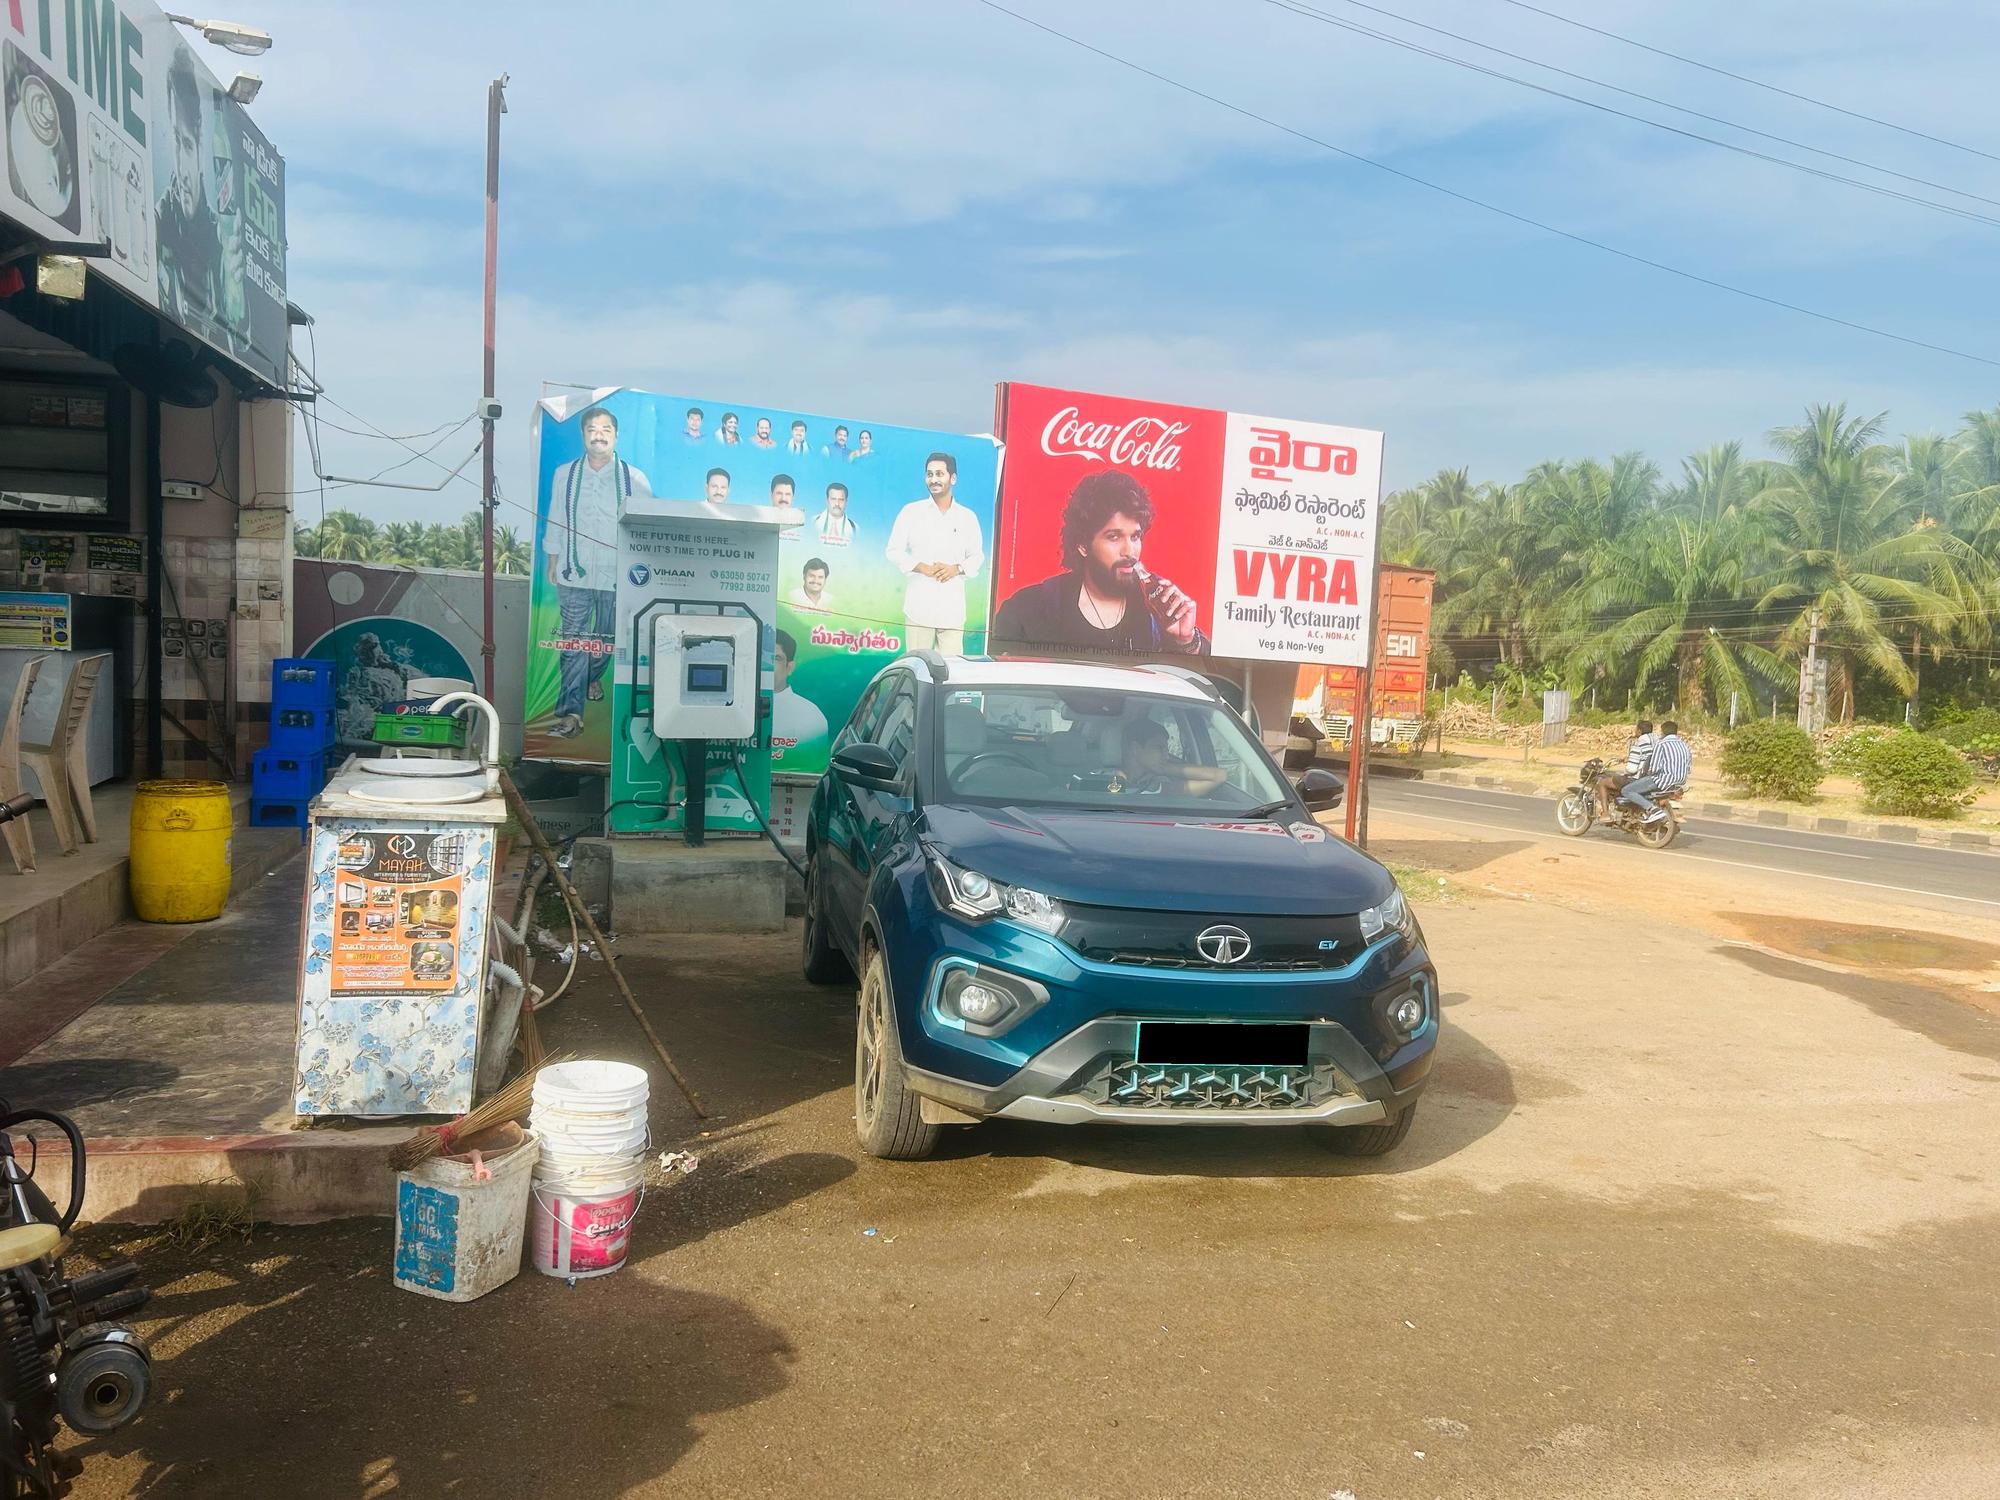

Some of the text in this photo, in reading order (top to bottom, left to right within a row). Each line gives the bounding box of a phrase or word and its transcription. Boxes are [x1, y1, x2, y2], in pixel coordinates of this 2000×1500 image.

[1041, 406, 1190, 471] Coca-Cola
[1249, 427, 1357, 482] వైరా
[630, 530, 648, 540] THE
[650, 532, 691, 543] FUTURE
[693, 535, 702, 544] IS
[629, 543, 755, 560] NOW IT'S TIME TO PLUG IN
[653, 568, 695, 578] VIHAAN
[1233, 549, 1359, 606] VYRA
[1224, 601, 1362, 631] Family Restaurant
[1258, 639, 1324, 654] Veg & Non-Veg
[1387, 634, 1416, 656] SAI
[533, 815, 571, 831] hinese
[1318, 940, 1339, 950] EV
